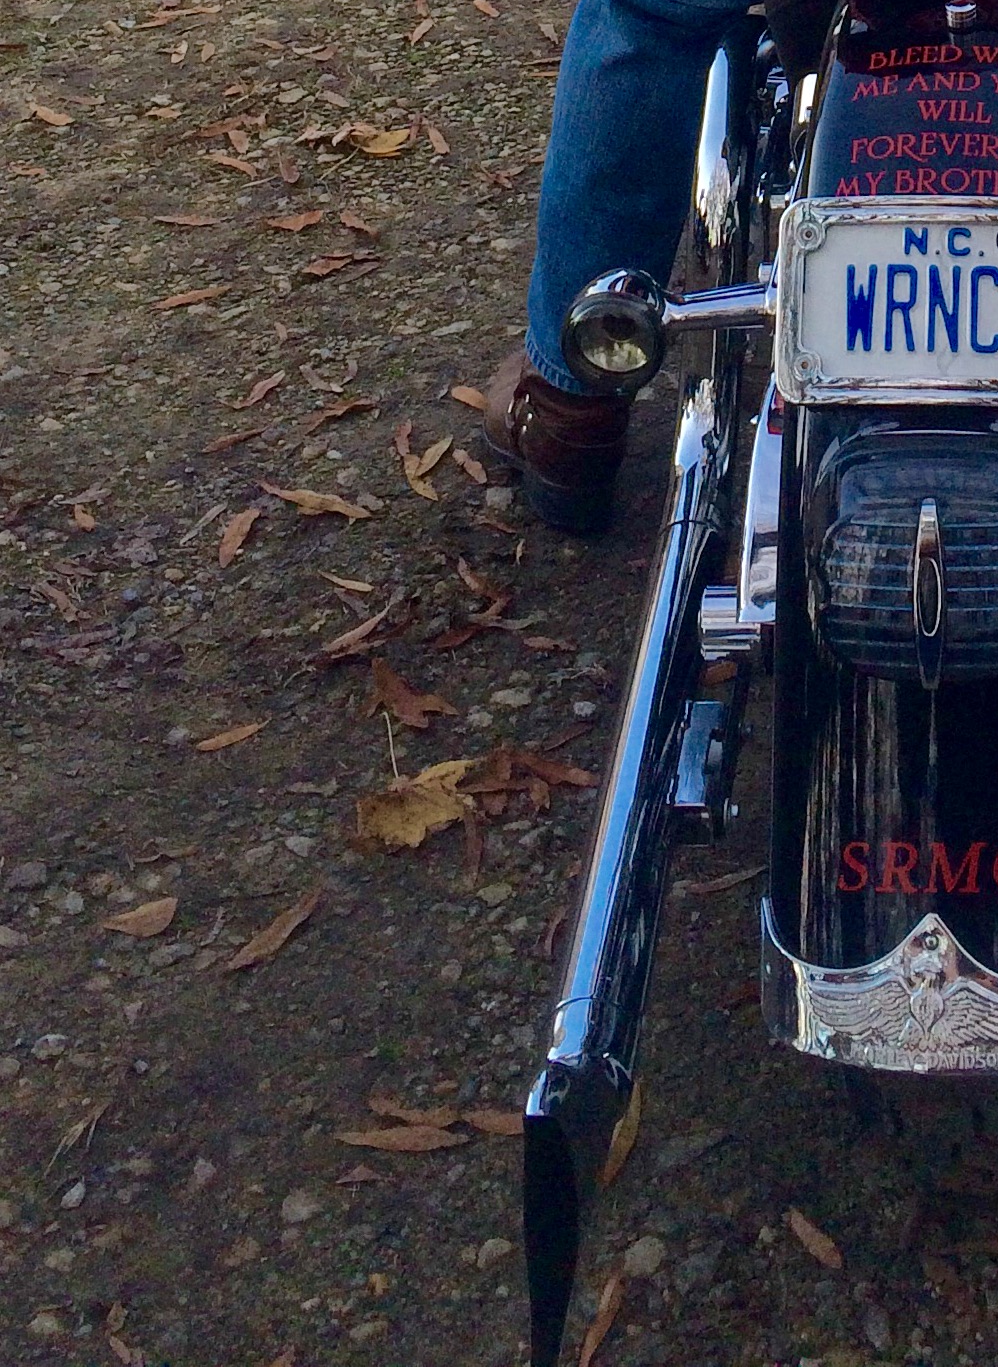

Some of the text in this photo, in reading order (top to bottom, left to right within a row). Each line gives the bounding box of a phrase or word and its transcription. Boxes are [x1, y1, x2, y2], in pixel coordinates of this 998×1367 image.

[868, 44, 963, 70] BLEED
[852, 76, 898, 102] ME
[906, 71, 981, 92] AND
[917, 99, 992, 124] WILL
[836, 170, 886, 197] MY
[903, 226, 985, 257] N.C.
